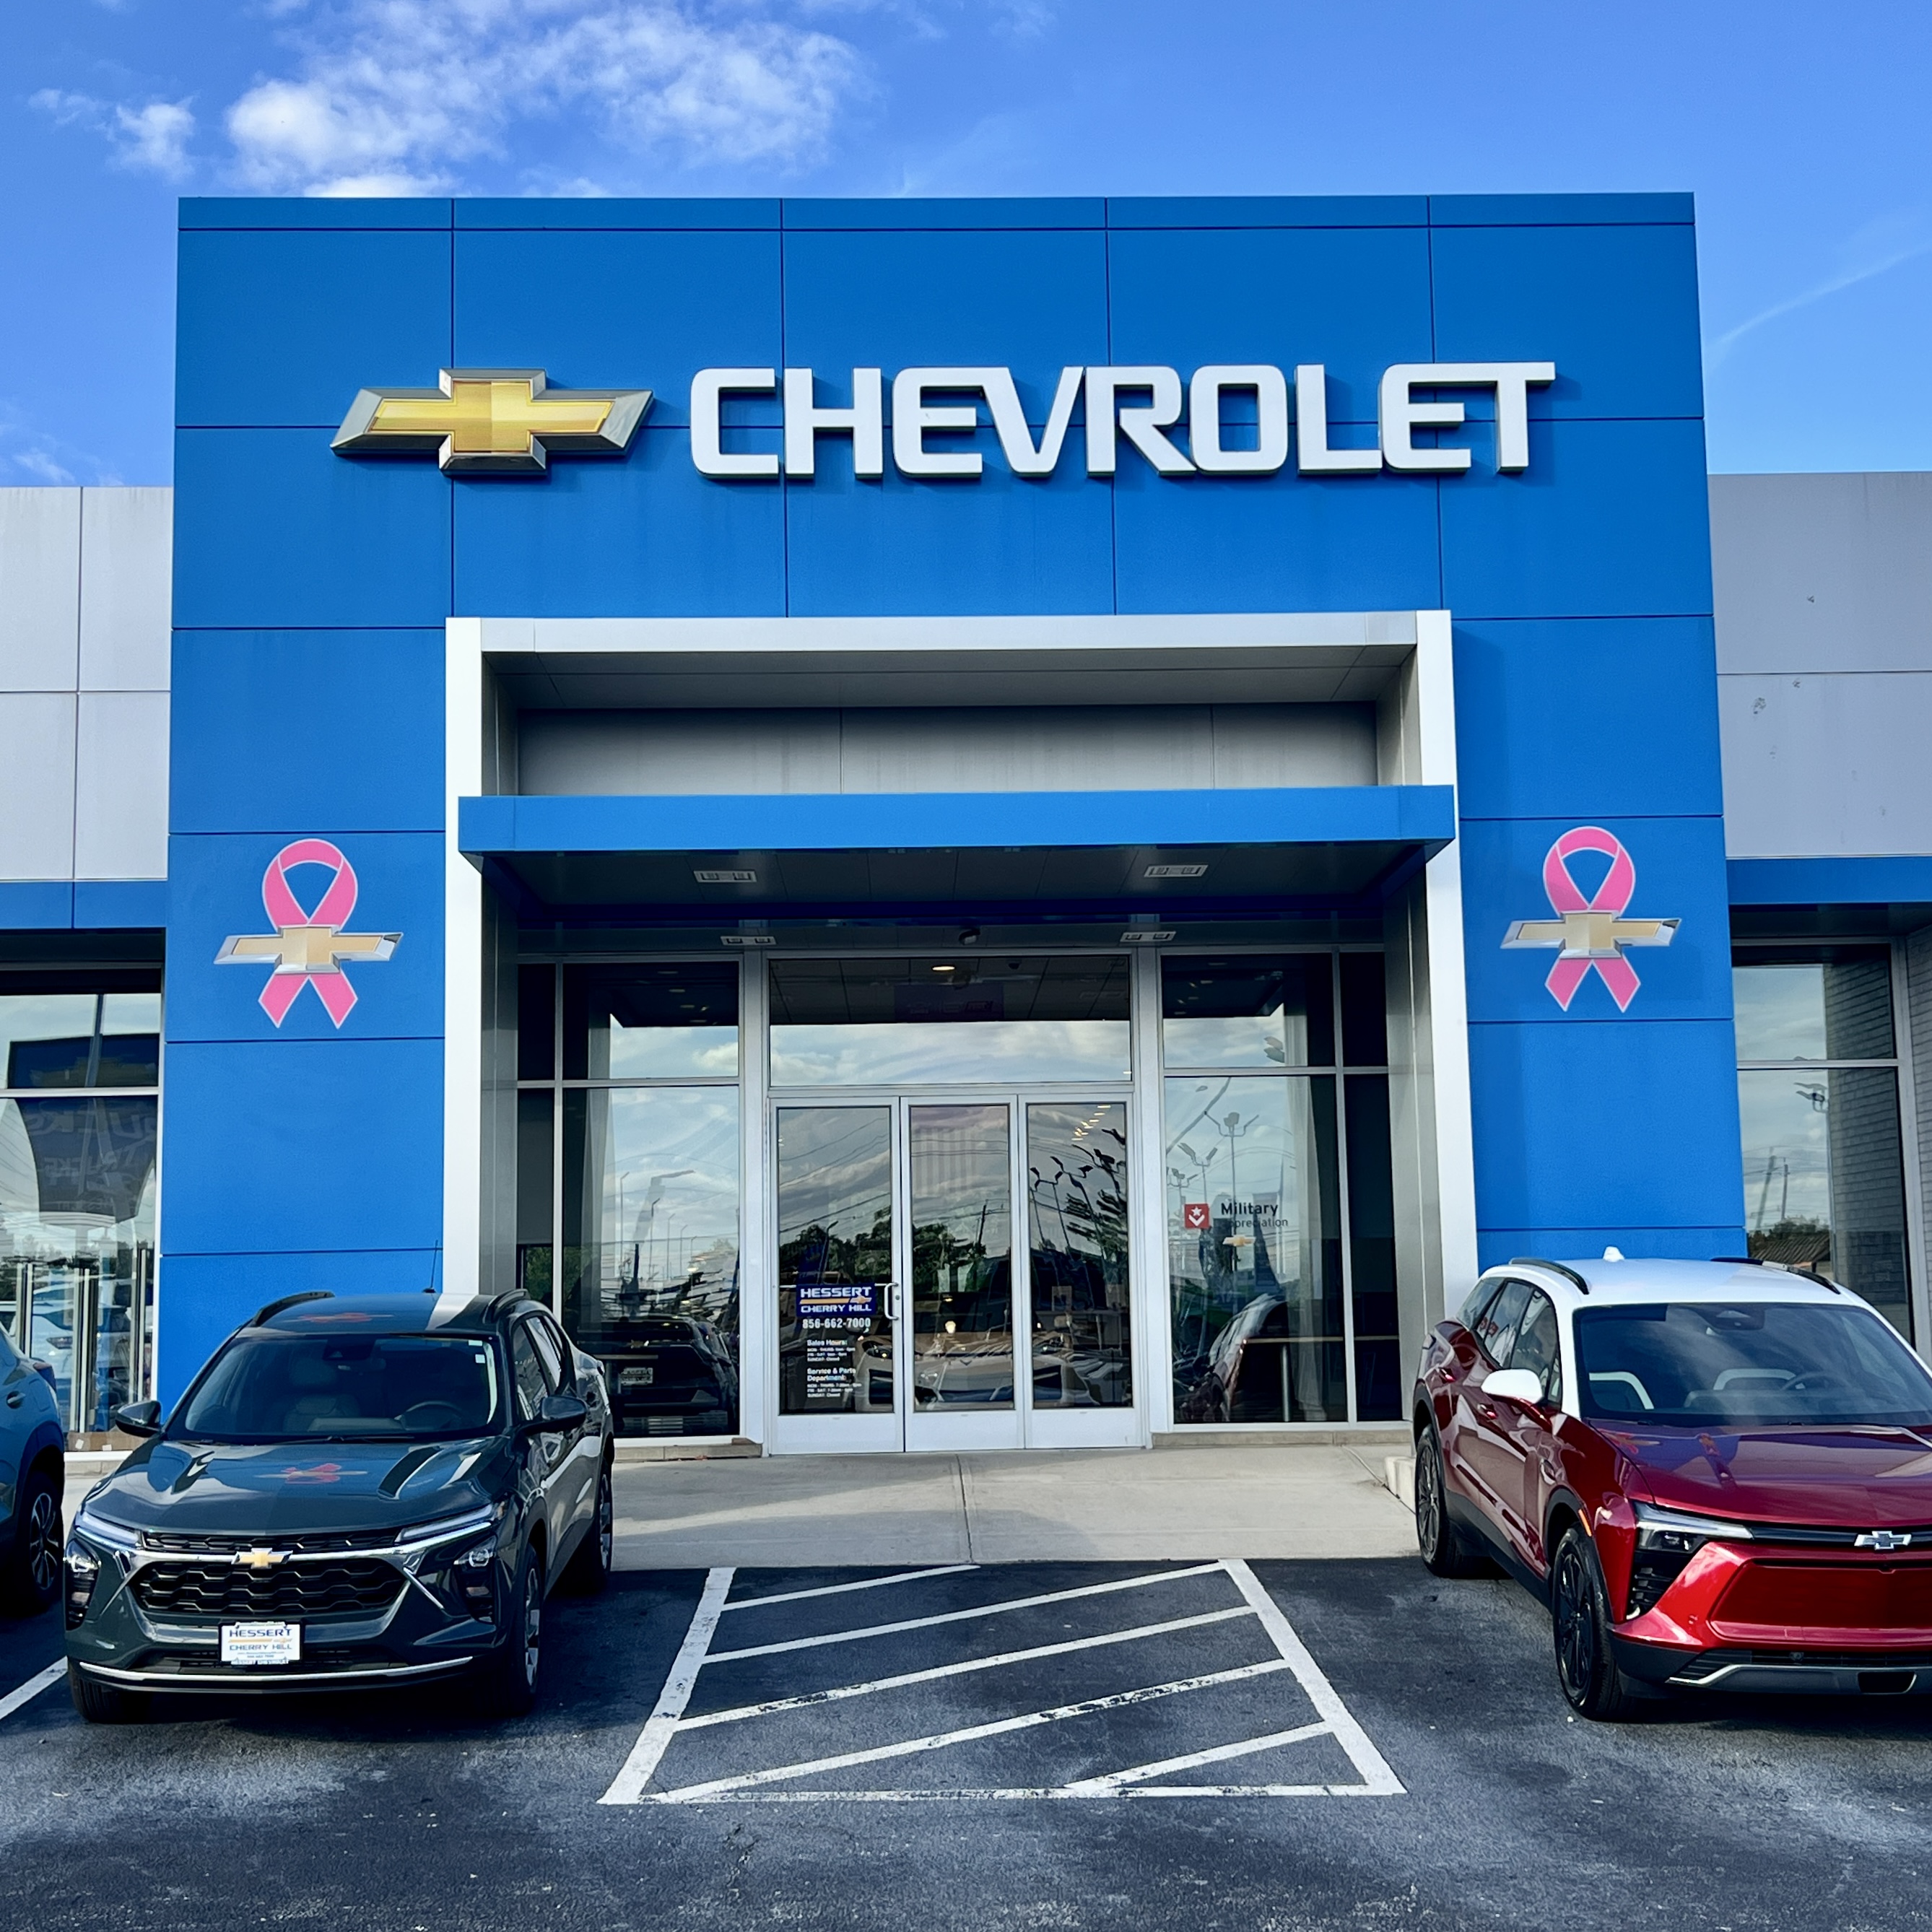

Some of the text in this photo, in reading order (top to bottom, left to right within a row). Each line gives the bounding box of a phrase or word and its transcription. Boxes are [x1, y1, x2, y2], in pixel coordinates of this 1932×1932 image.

[690, 362, 1556, 479] CHEVROLET
[1221, 1202, 1279, 1217] Military
[800, 1287, 872, 1298] HESSERT
[801, 1305, 845, 1313] CHERRY
[802, 1318, 871, 1329] 856-662-7000
[229, 1628, 292, 1637] HESSERT
